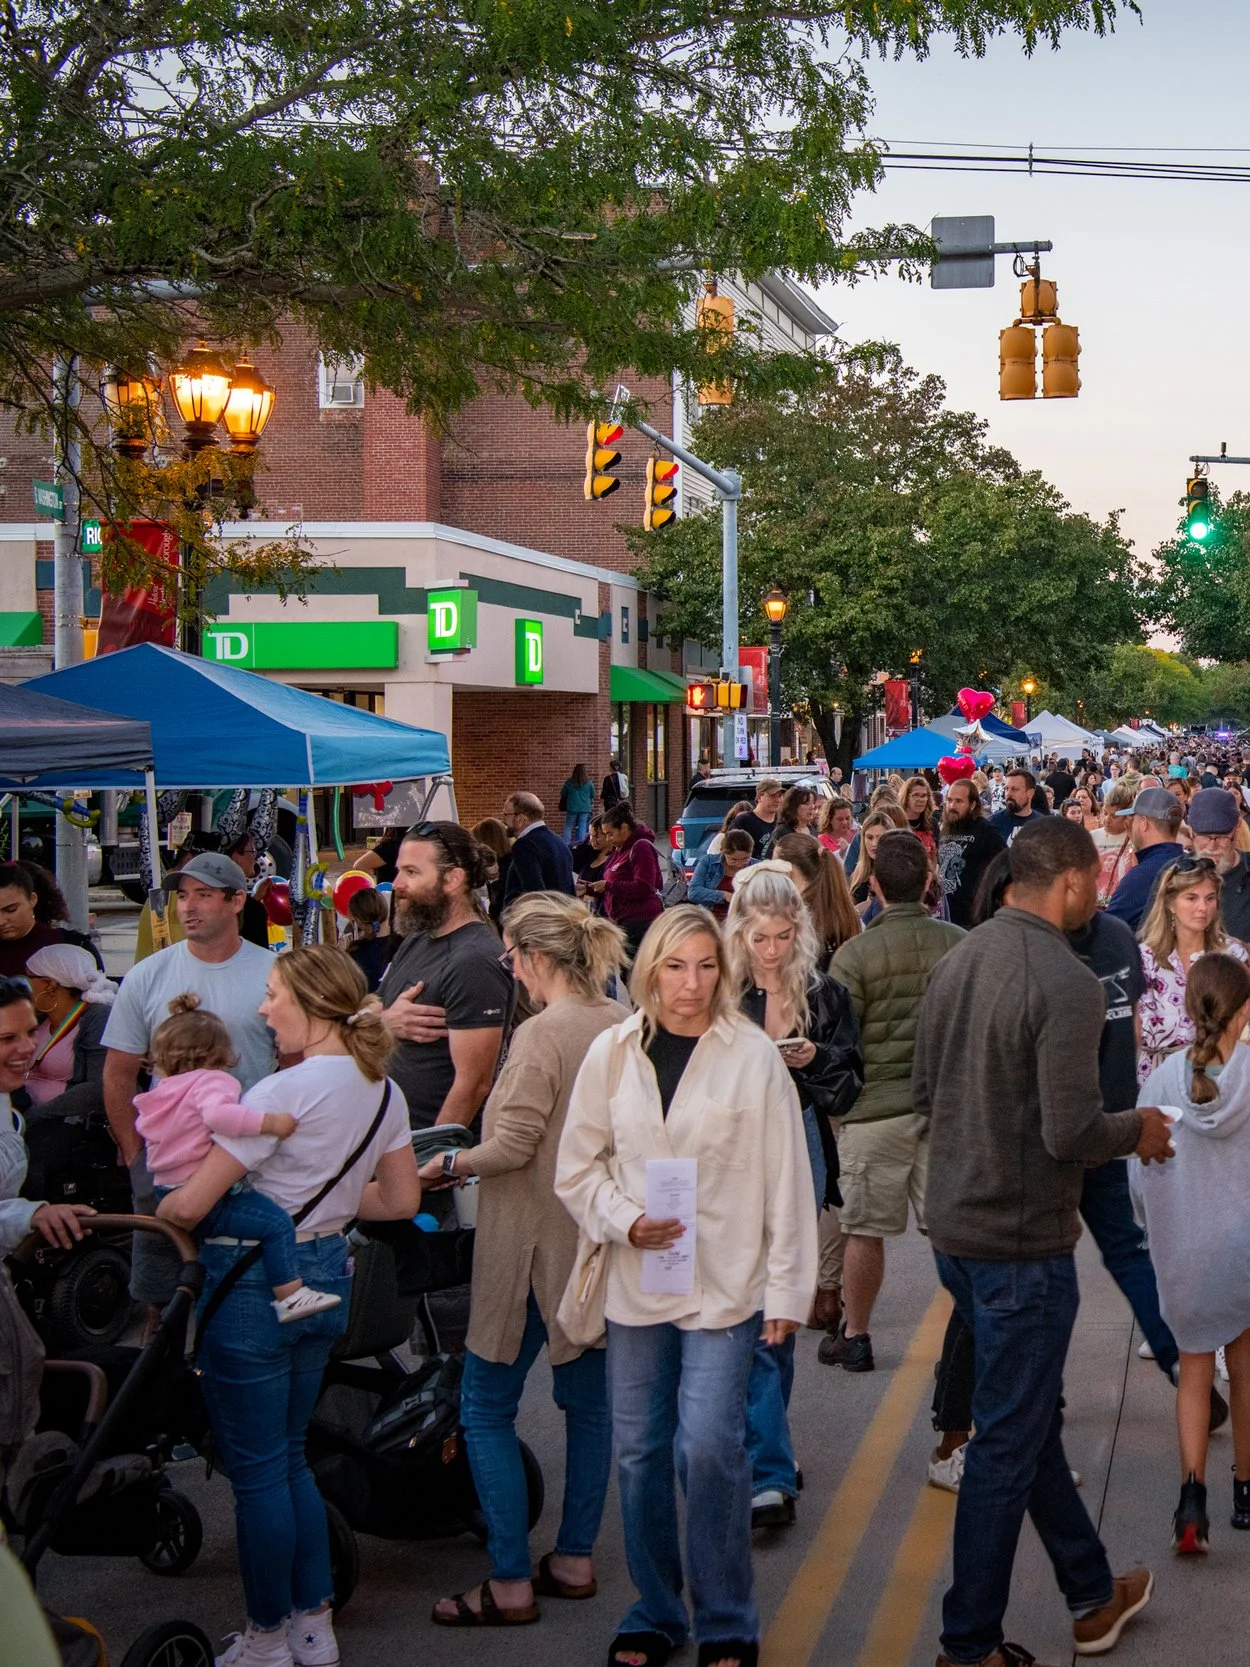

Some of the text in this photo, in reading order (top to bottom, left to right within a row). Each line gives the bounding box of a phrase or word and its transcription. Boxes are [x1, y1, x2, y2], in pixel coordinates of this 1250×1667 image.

[430, 601, 457, 638] TD
[207, 631, 249, 660] TD
[525, 631, 542, 673] TD
